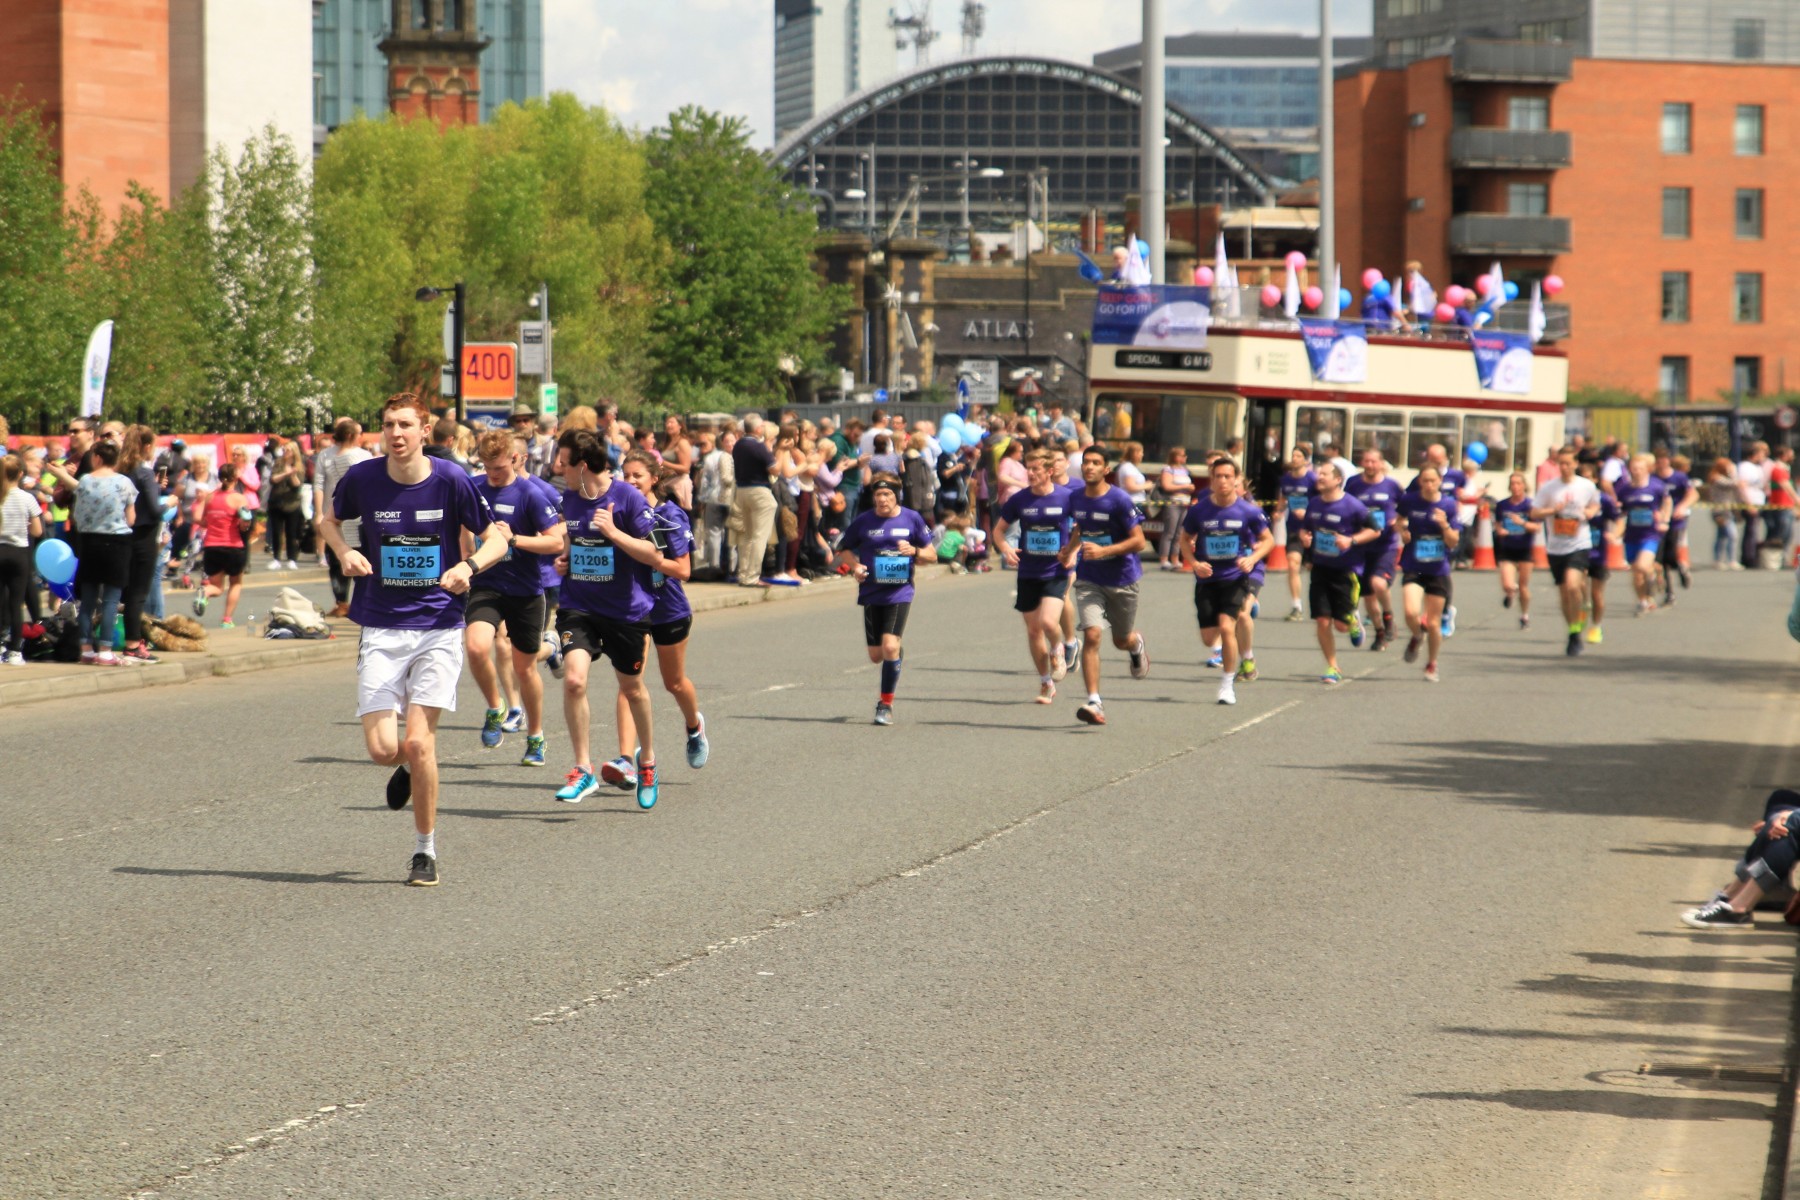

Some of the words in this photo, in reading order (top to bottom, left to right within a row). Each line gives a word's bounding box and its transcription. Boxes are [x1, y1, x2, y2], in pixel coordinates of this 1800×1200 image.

[1100, 304, 1113, 314] GO
[1116, 304, 1135, 315] FOR
[1128, 353, 1162, 365] SPECIAL
[466, 352, 511, 380] 400
[388, 556, 435, 568] 15825
[574, 554, 609, 566] 21208
[383, 578, 438, 587] MANCHESTER
[571, 574, 614, 582] MANCHESTER
